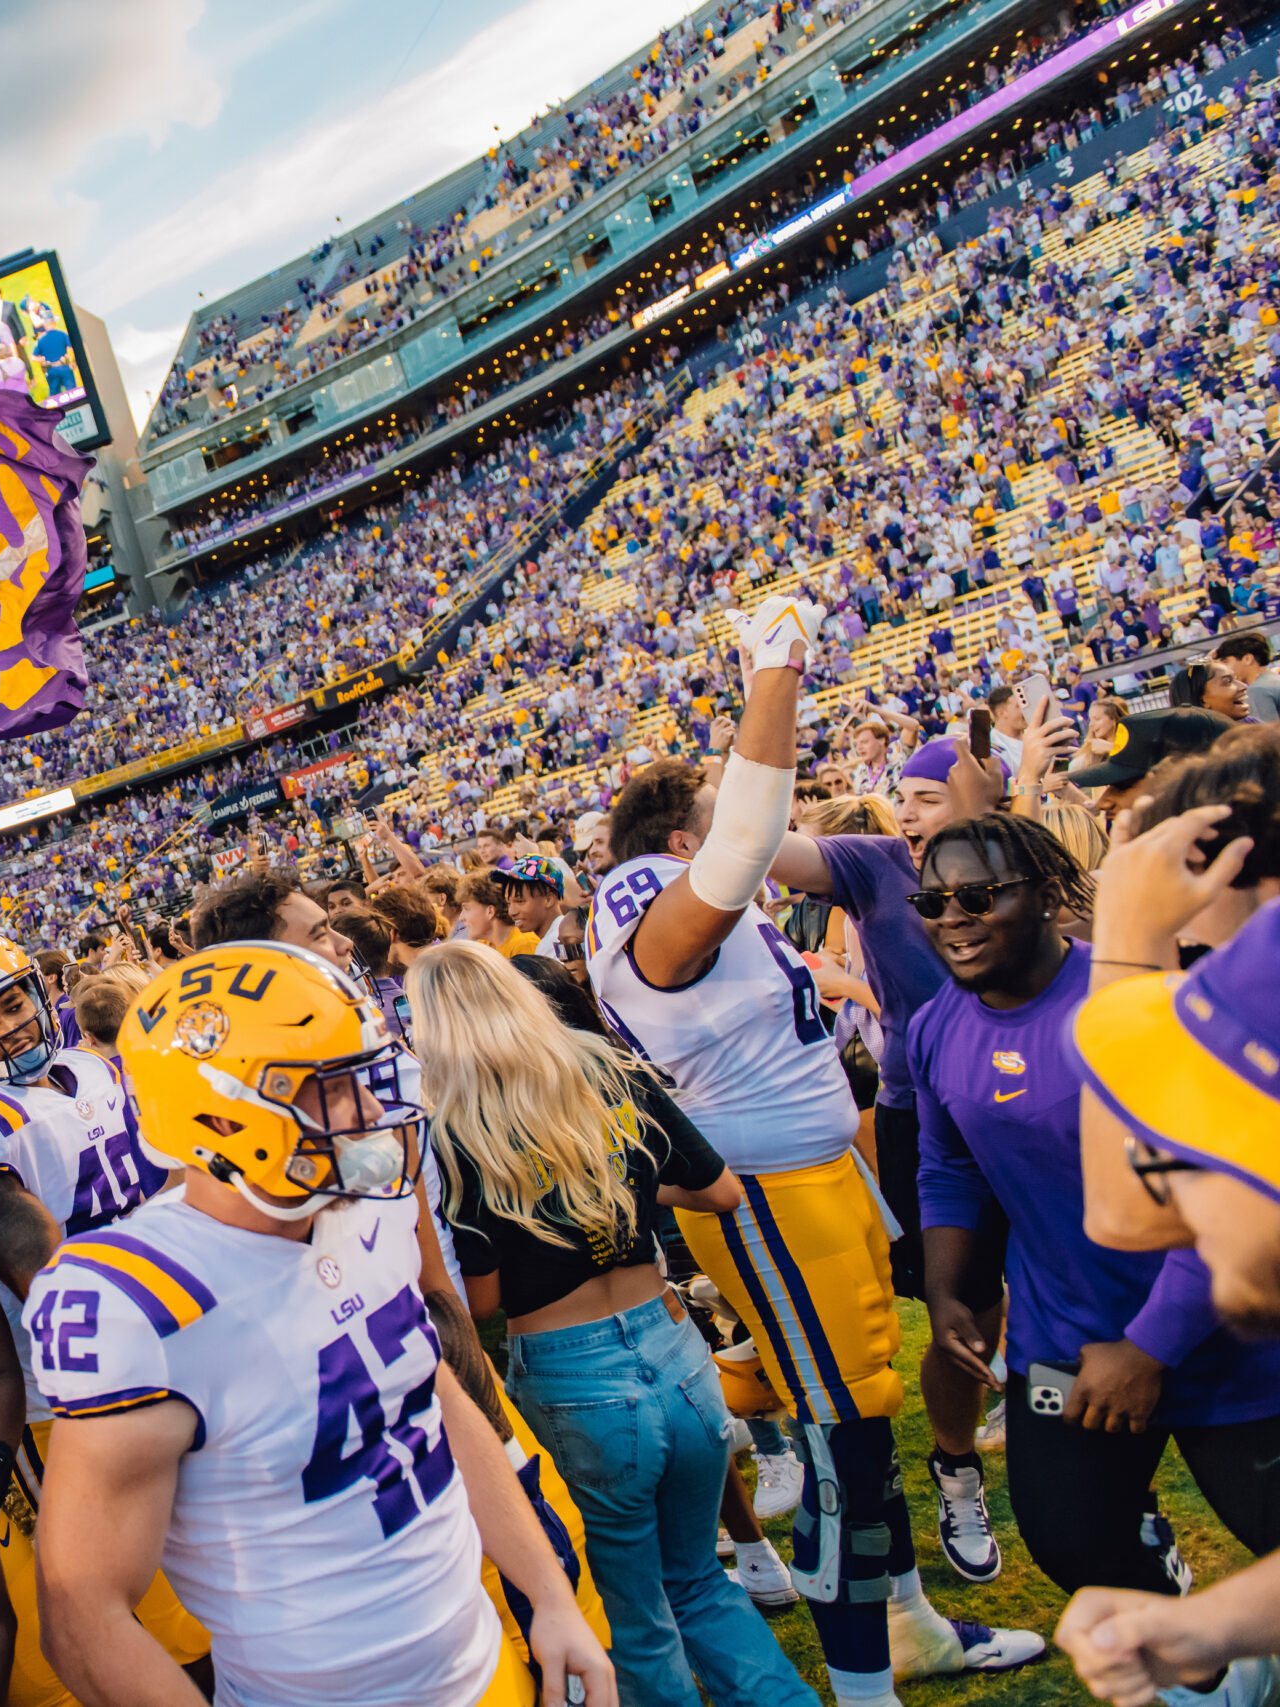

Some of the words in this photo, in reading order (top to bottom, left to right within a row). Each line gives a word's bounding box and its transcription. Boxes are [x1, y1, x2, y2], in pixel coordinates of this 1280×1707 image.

[337, 672, 385, 704] RoofClaim
[212, 804, 239, 821] CAMPUS
[248, 788, 279, 806] FEDERAL
[605, 867, 664, 928] 69
[137, 962, 278, 1035] LSU
[31, 1290, 100, 1373] 42
[331, 1293, 365, 1326] LSU
[301, 1283, 455, 1540] 42
